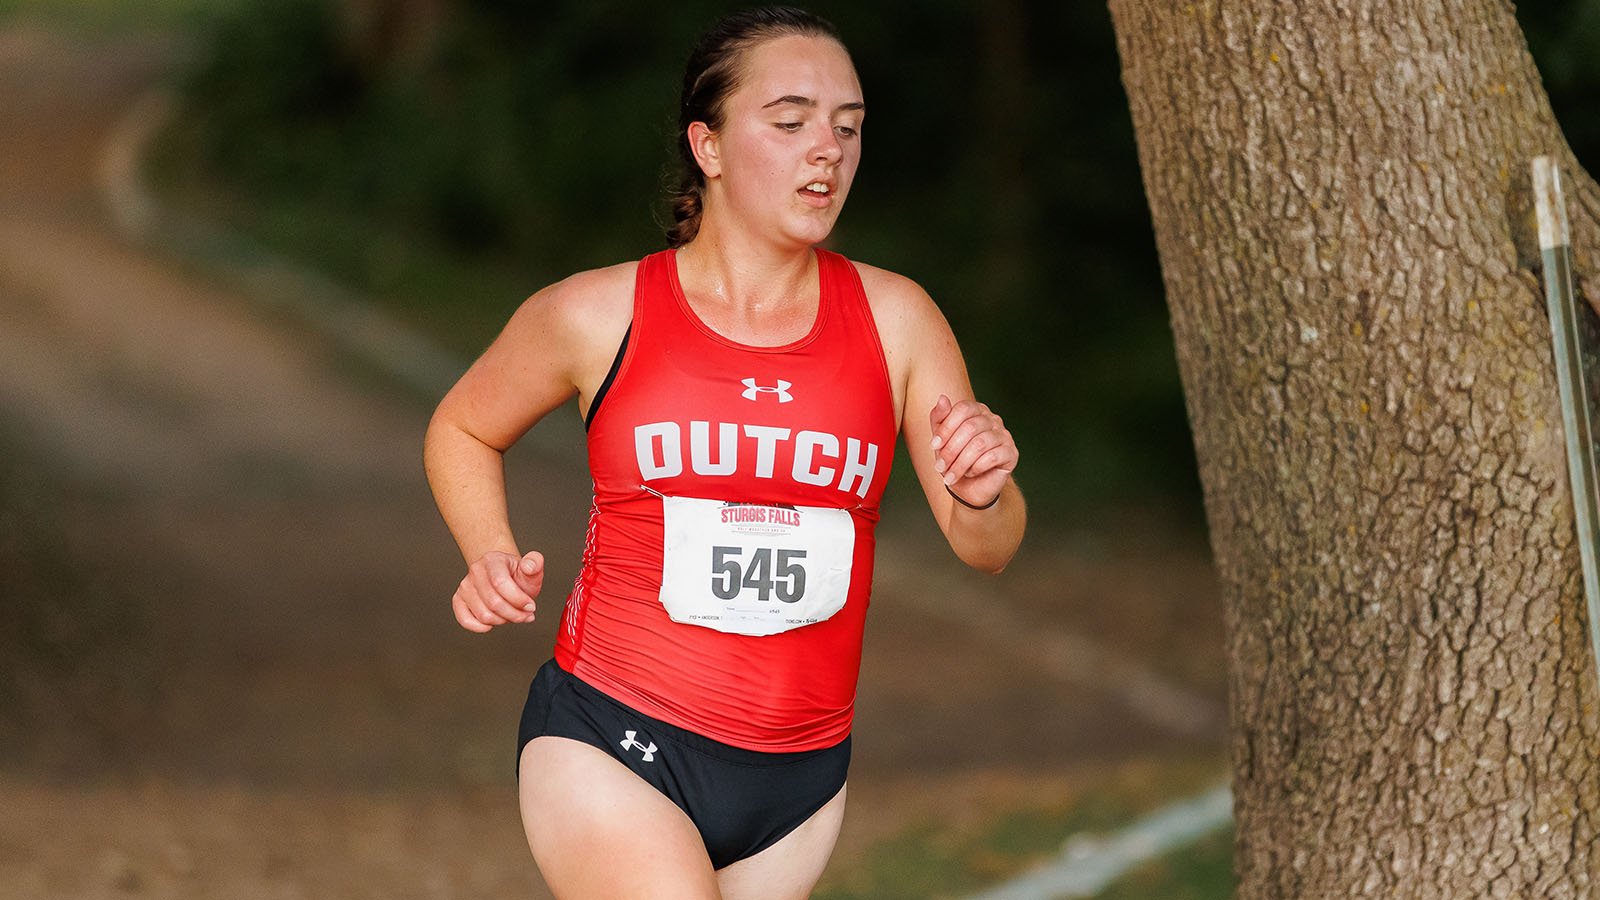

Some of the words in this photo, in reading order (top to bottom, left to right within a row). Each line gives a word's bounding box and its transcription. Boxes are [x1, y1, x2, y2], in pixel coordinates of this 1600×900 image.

[634, 421, 879, 499] DUTCH
[721, 507, 766, 523] STURGIS
[768, 509, 801, 527] FALLS
[711, 545, 807, 603] 545
